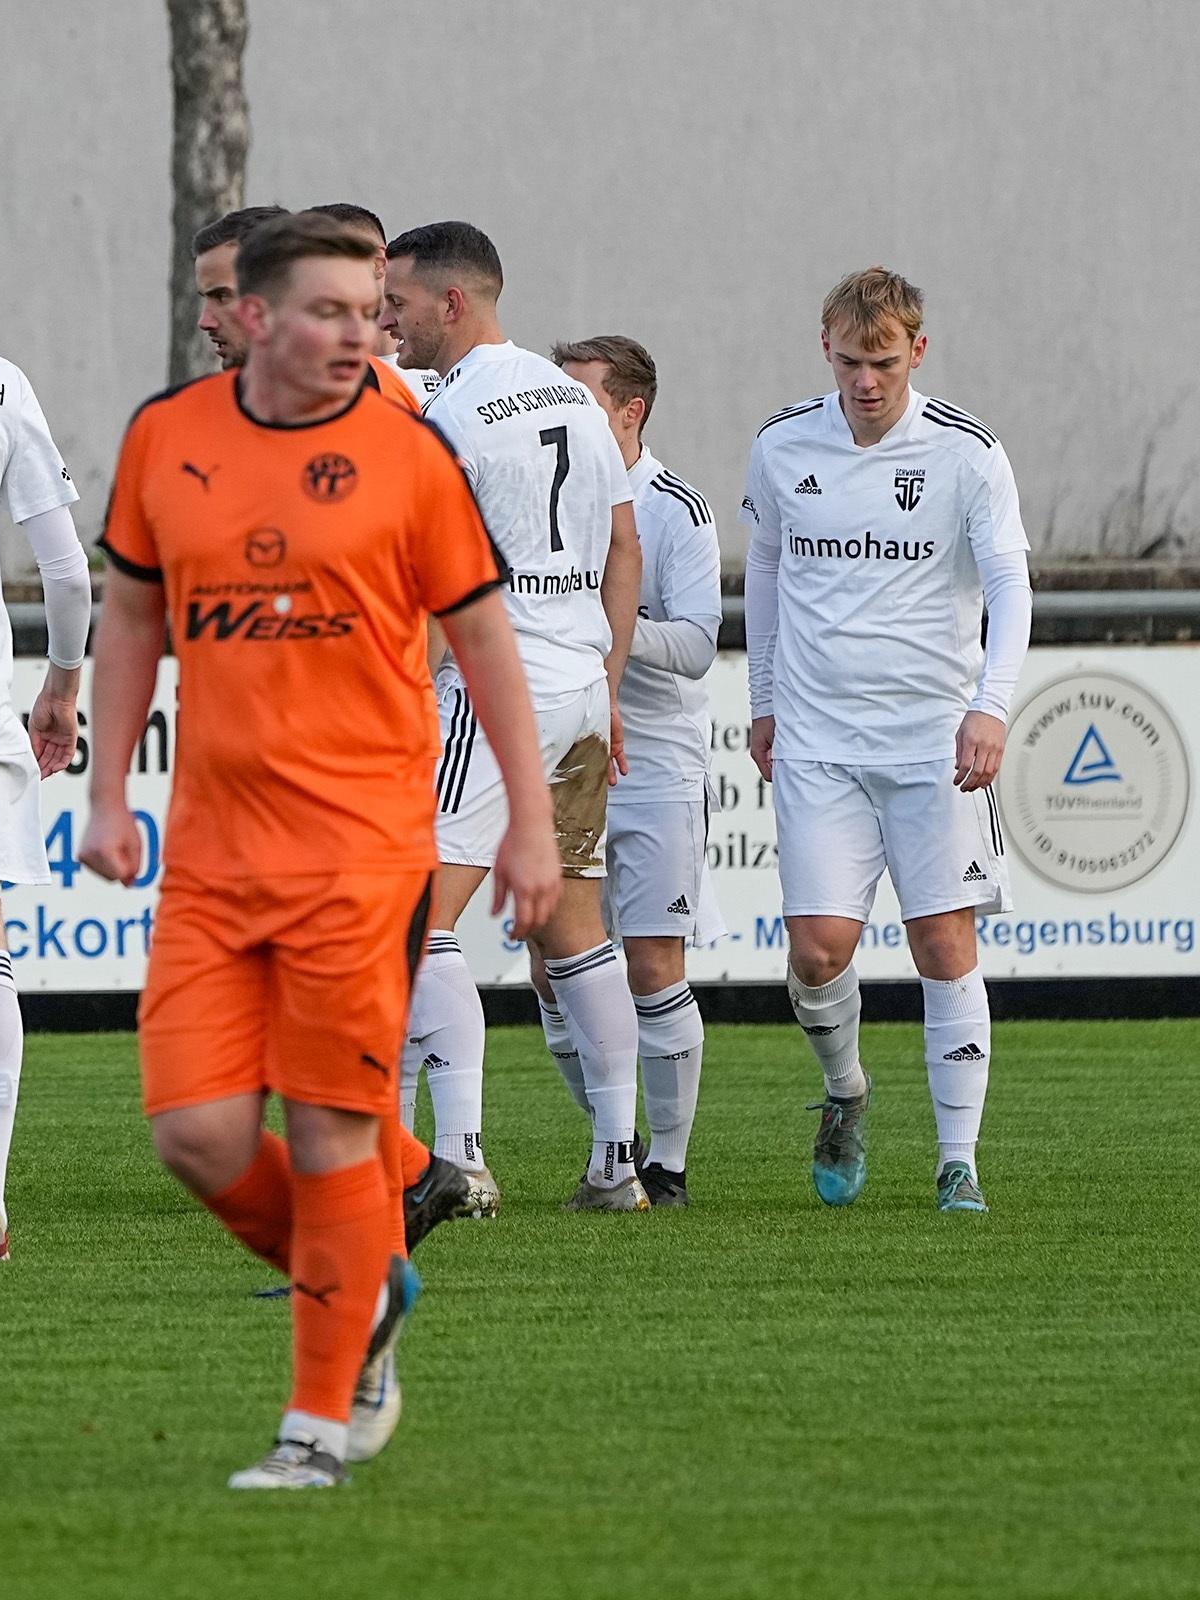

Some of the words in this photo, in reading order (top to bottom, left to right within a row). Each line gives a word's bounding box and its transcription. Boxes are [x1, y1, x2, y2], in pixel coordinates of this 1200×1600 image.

[476, 396, 521, 425] SC04
[516, 385, 591, 412] SCHWABACH
[895, 468, 926, 477] SCHWABACH
[538, 425, 570, 553] 7
[794, 486, 823, 495] adidas
[789, 527, 935, 561] immohaus
[509, 566, 599, 595] immohau
[185, 602, 359, 641] WEISS
[1025, 691, 1161, 748] www.tuv.com
[962, 872, 988, 882] adidas
[666, 905, 691, 915] adidas
[975, 911, 1195, 955] Regensburg
[942, 1052, 987, 1063] adidas
